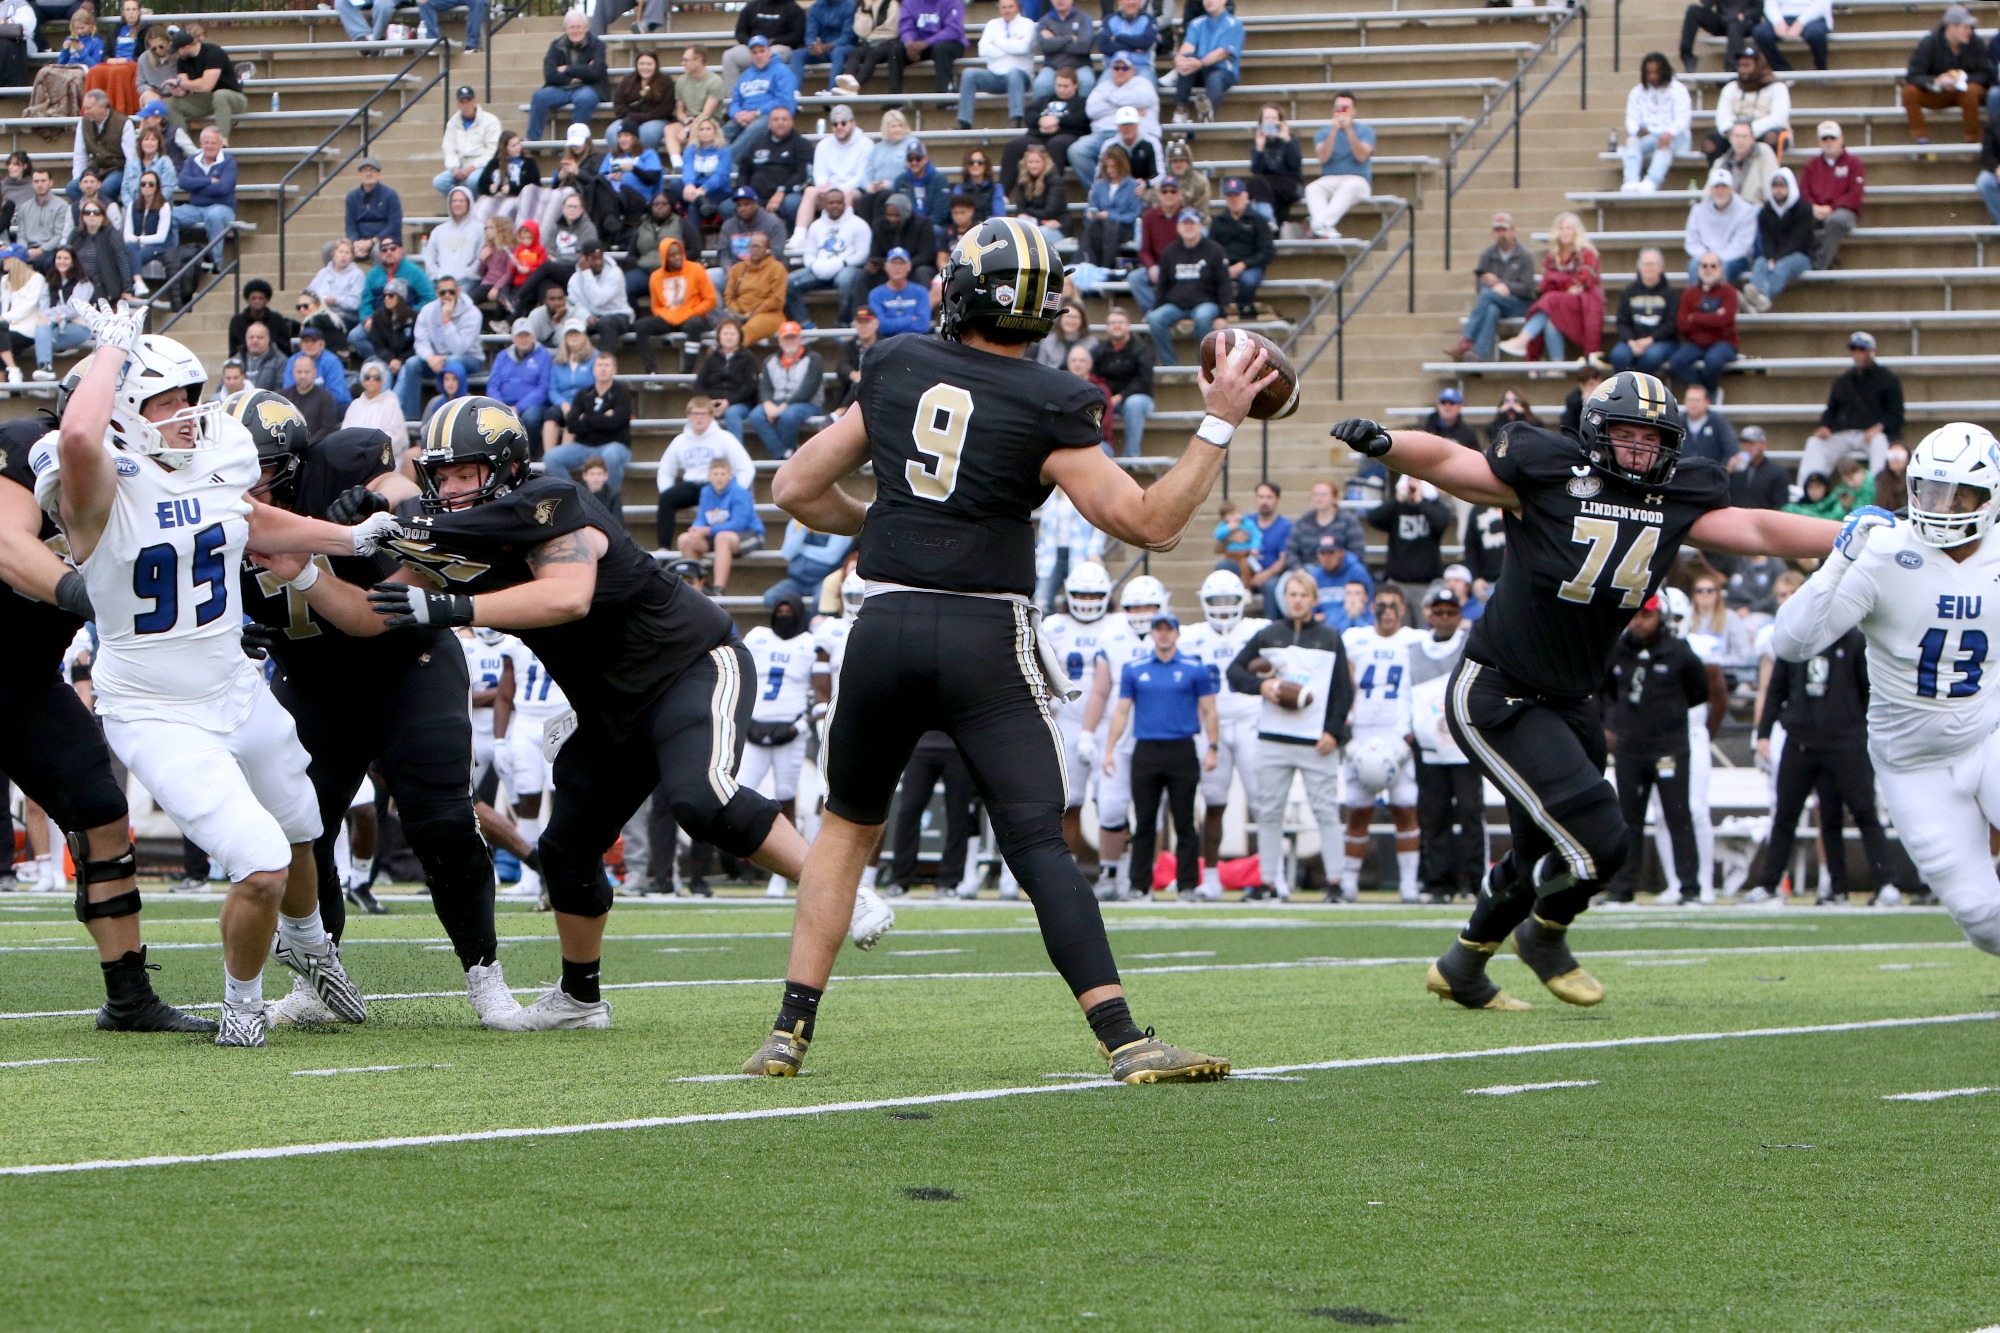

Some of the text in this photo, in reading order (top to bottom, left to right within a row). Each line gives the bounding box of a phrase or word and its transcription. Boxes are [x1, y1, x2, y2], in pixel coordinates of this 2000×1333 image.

[189, 369, 200, 378] EIU
[904, 382, 975, 503] 9
[1934, 469, 1947, 477] EIU
[154, 497, 202, 530] EIU
[1580, 500, 1664, 524] LINDENWOOD
[132, 521, 228, 636] 95
[1556, 515, 1662, 609] 74
[1935, 594, 1982, 620] EIU
[480, 659, 500, 669] EIU
[770, 651, 790, 663] EIU
[1916, 627, 1989, 699] 13
[524, 665, 553, 701] 11
[1358, 664, 1403, 700] 49
